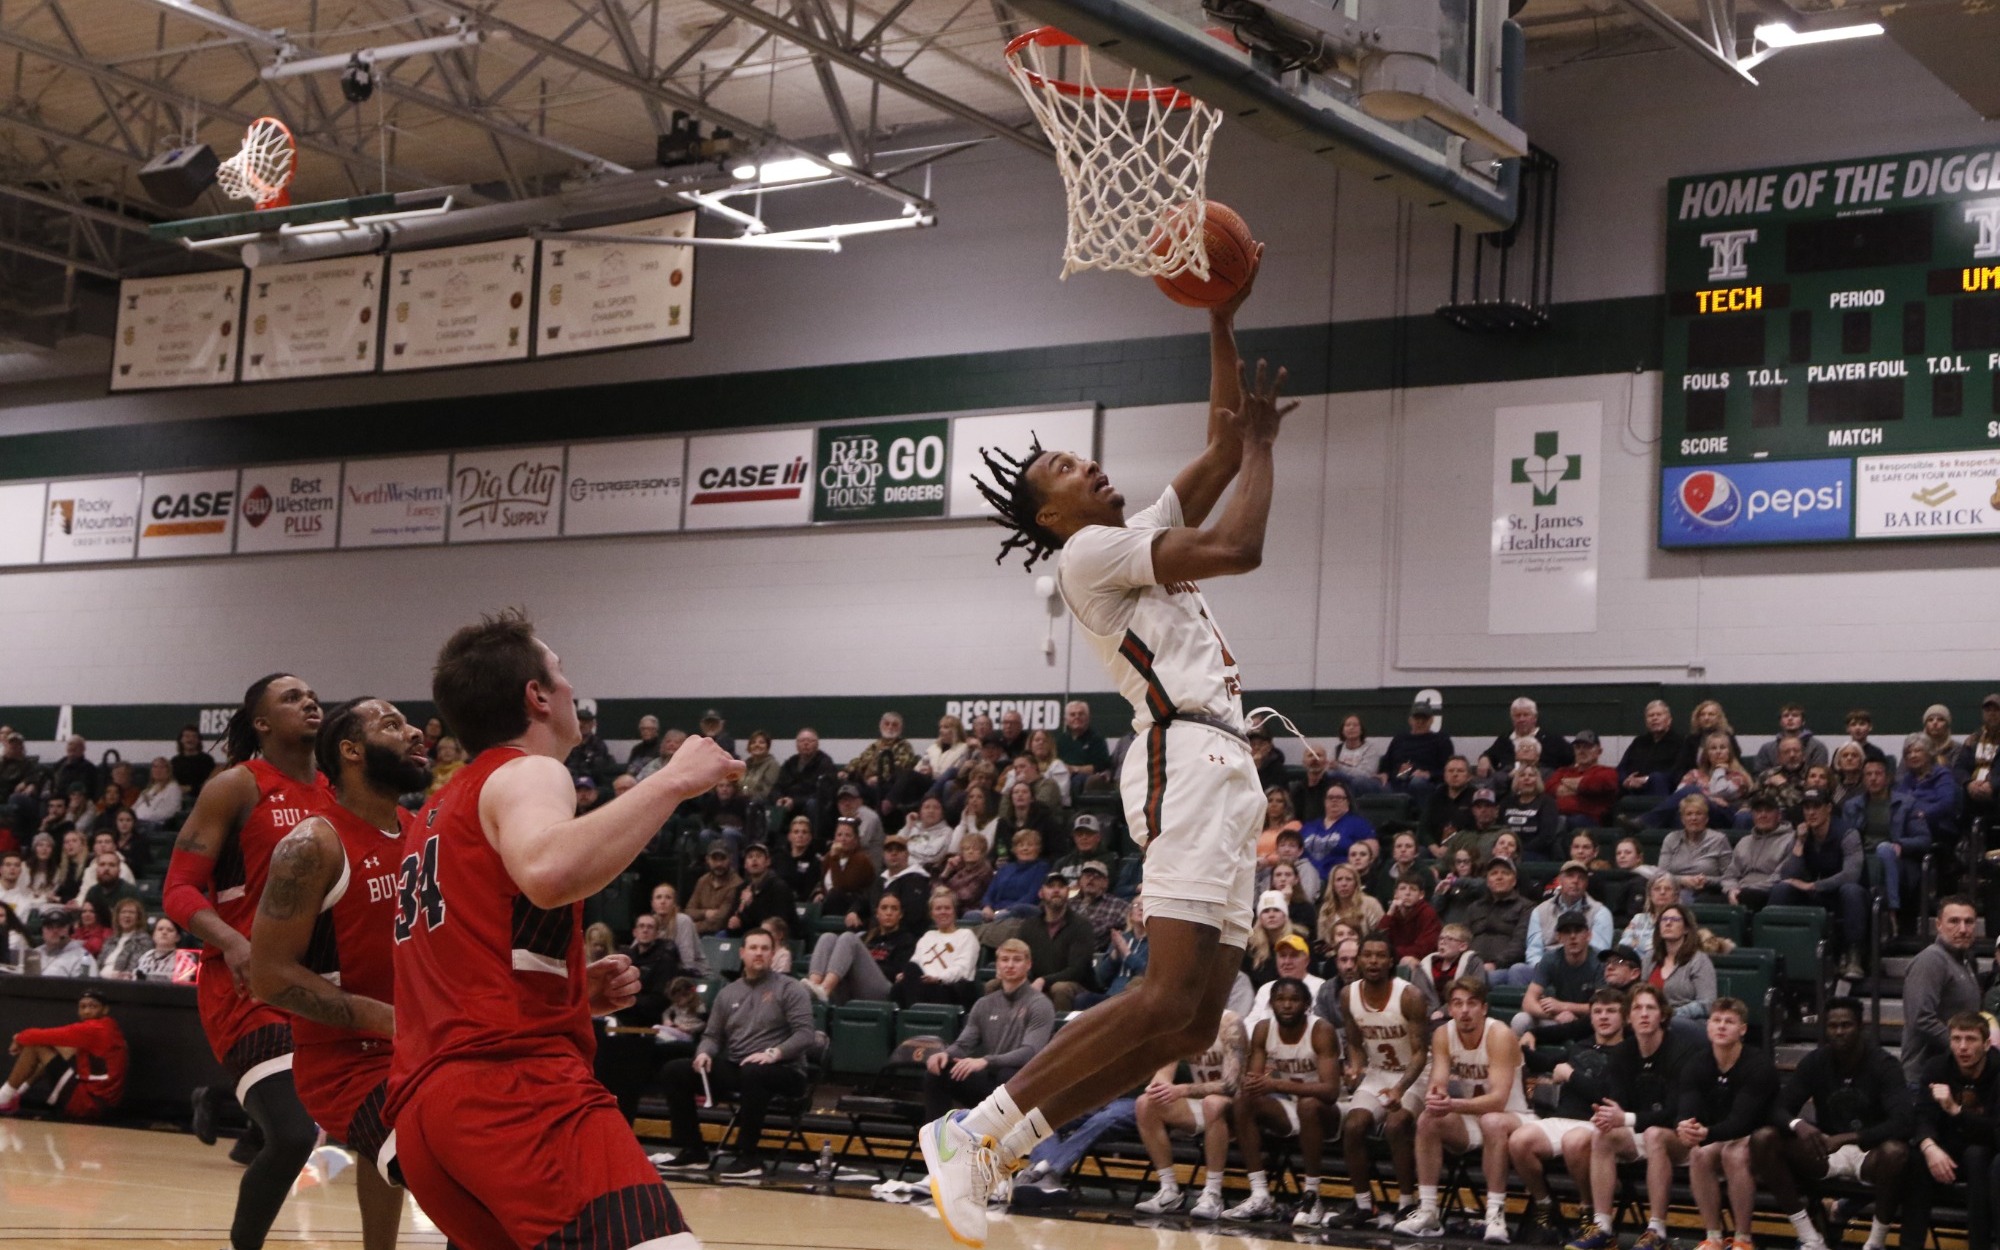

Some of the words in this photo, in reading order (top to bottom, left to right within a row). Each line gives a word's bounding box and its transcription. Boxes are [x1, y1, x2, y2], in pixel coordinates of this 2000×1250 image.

[1679, 174, 1778, 220] HOME
[1782, 169, 1828, 210] OF
[1834, 162, 1898, 205] THE
[1962, 265, 2000, 291] UM
[1696, 286, 1763, 314] TECH
[1830, 289, 1885, 310] PERIOD
[1808, 362, 1866, 383] PLAYER
[1869, 360, 1908, 379] FOUL
[1927, 355, 1970, 374] T.O.L.
[1989, 353, 2000, 370] F
[1683, 372, 1730, 391] FOULS
[1748, 369, 1788, 386] T.O.L.
[1828, 428, 1883, 447] MATCH
[1988, 421, 2000, 438] S
[1681, 437, 1728, 455] SCORE
[888, 435, 944, 480] GO
[588, 477, 680, 493] TORGERSON'S
[700, 464, 778, 490] CASE
[821, 462, 883, 490] CHOP
[1870, 474, 1880, 482] BE
[1882, 473, 1902, 481] SAFE
[1904, 472, 1918, 480] ON
[1921, 471, 1945, 480] YOUR
[1947, 470, 1968, 479] WAY
[1970, 468, 1998, 478] HOME
[290, 477, 322, 494] Best
[348, 482, 443, 505] NorthWestern
[456, 467, 503, 523] Dig
[507, 460, 560, 506] City
[884, 484, 944, 503] DIGGERS
[77, 498, 114, 513] Rocky
[152, 491, 234, 520] CASE
[276, 497, 333, 513] Western
[827, 487, 877, 507] HOUSE
[1748, 481, 1843, 520] pepsi
[76, 514, 134, 530] Mountain
[284, 515, 322, 533] PLUS
[1508, 513, 1528, 531] St.
[1531, 513, 1584, 533] James
[1884, 508, 1984, 528] BARRICK
[1500, 533, 1592, 550] Healthcare
[394, 834, 446, 946] 34
[1377, 1043, 1401, 1071] 3
